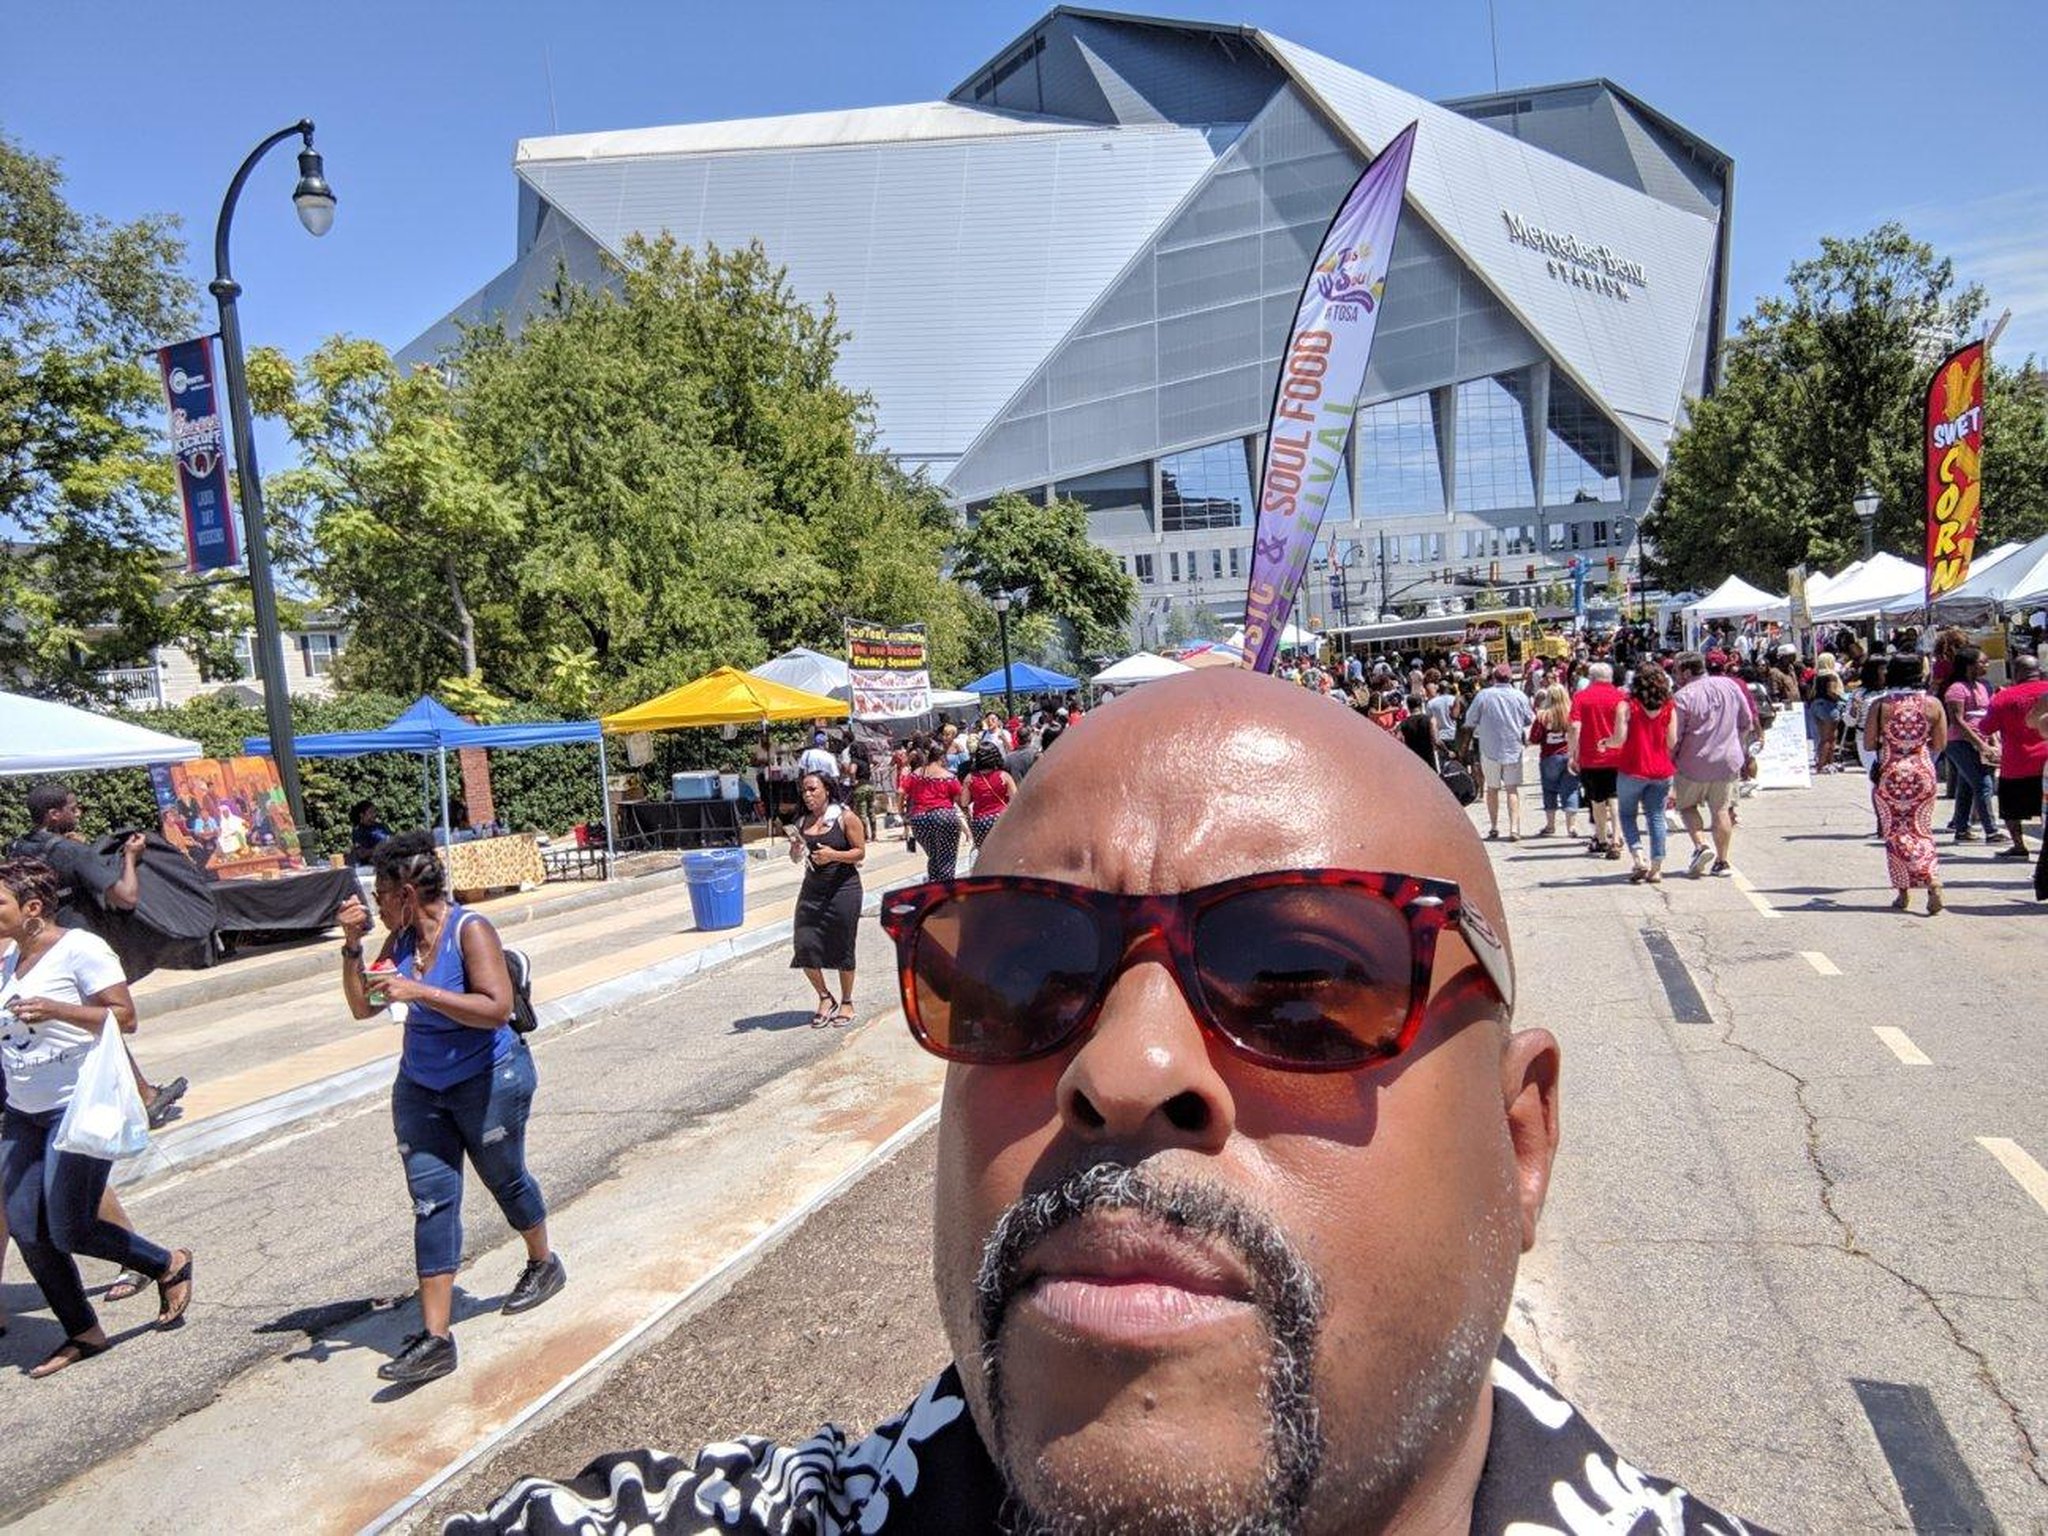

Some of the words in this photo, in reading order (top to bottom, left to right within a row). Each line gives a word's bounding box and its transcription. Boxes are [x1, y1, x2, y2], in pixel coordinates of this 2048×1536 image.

[1279, 330, 1333, 424] FOOD
[1264, 430, 1312, 516] SOUL
[1256, 534, 1288, 565] &
[1930, 446, 1964, 593] CORN
